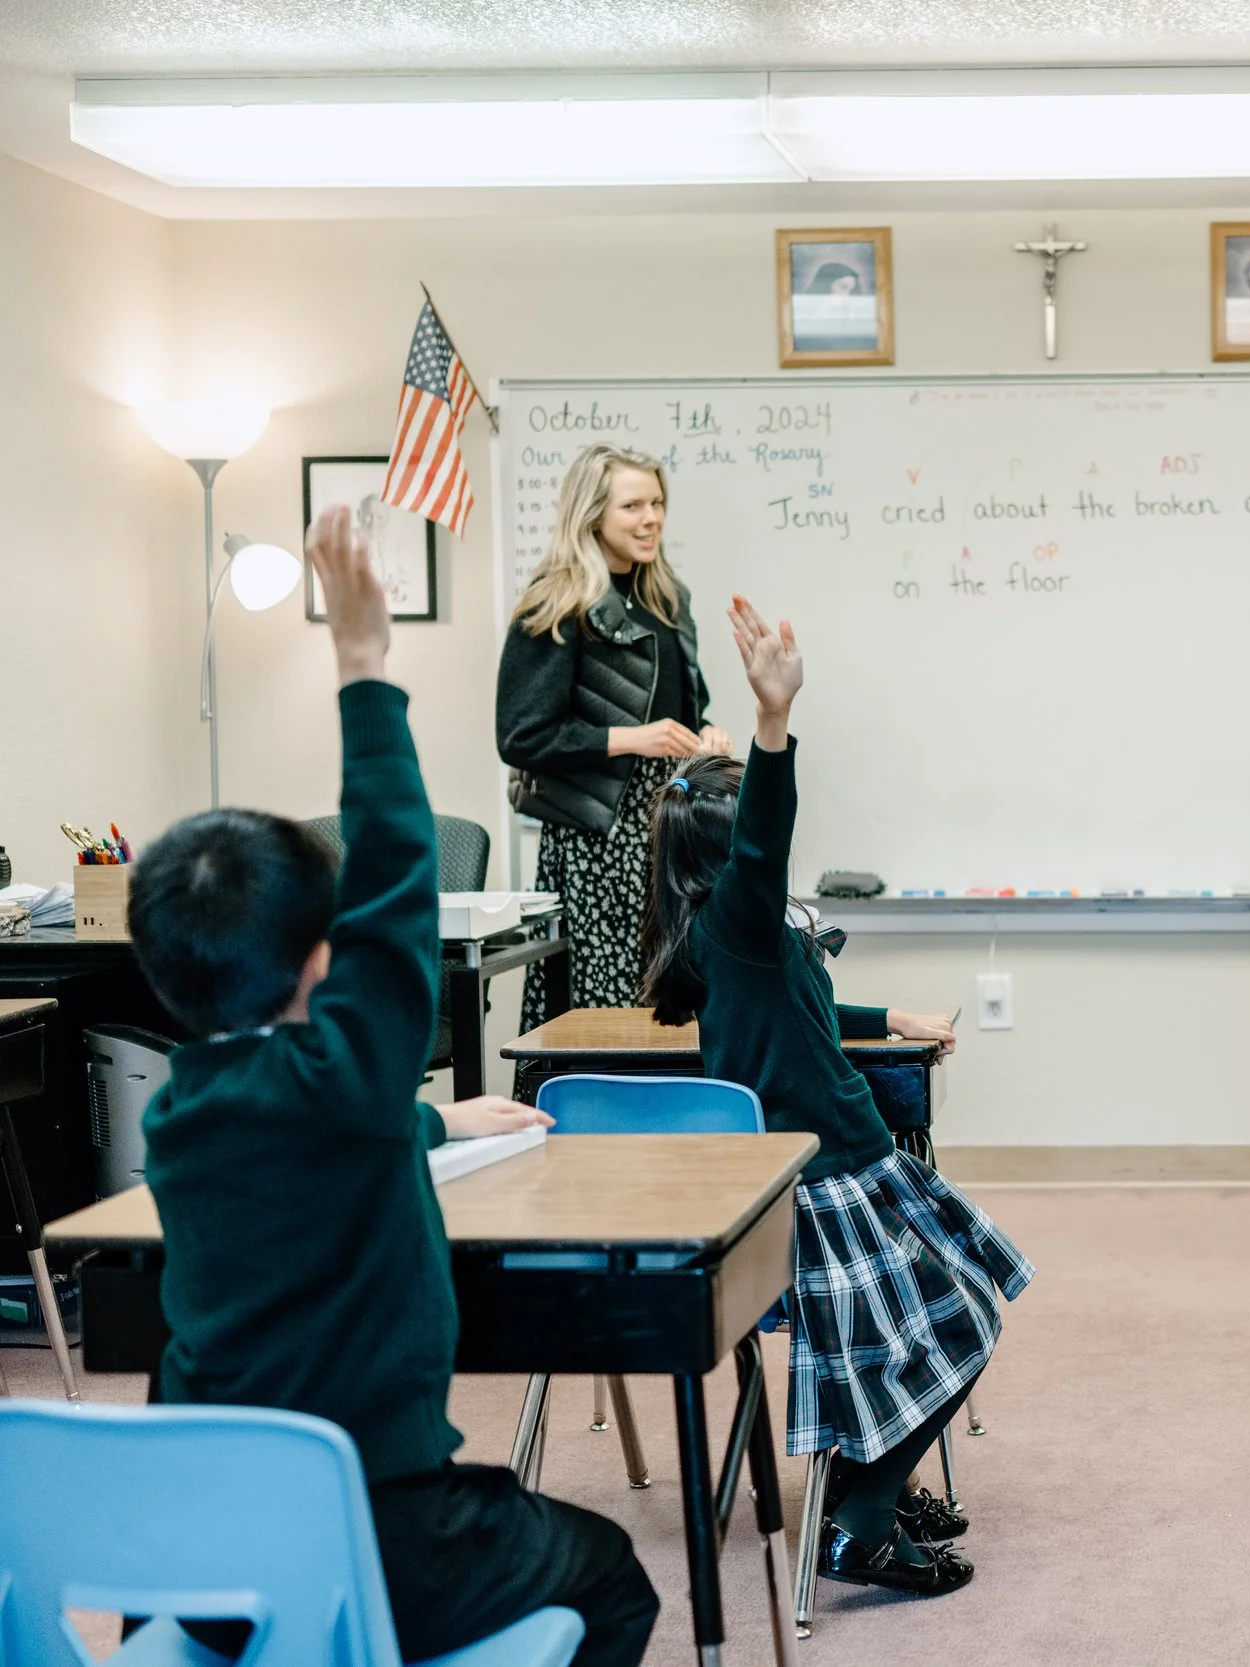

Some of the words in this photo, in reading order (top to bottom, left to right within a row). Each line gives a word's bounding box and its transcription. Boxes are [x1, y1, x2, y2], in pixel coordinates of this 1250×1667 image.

[529, 402, 640, 433] October
[757, 402, 833, 436] 2024
[522, 446, 566, 467] Our
[661, 445, 681, 474] of
[695, 444, 736, 464] the
[748, 443, 827, 478] Rosary
[1160, 453, 1203, 475] ADJ
[768, 496, 850, 541] Jenny
[881, 496, 946, 525] cried
[973, 494, 1049, 521] about
[1073, 490, 1117, 520] the
[1134, 490, 1221, 517] broken
[893, 581, 920, 599] on
[950, 563, 988, 596] the
[1005, 562, 1071, 593] floor
